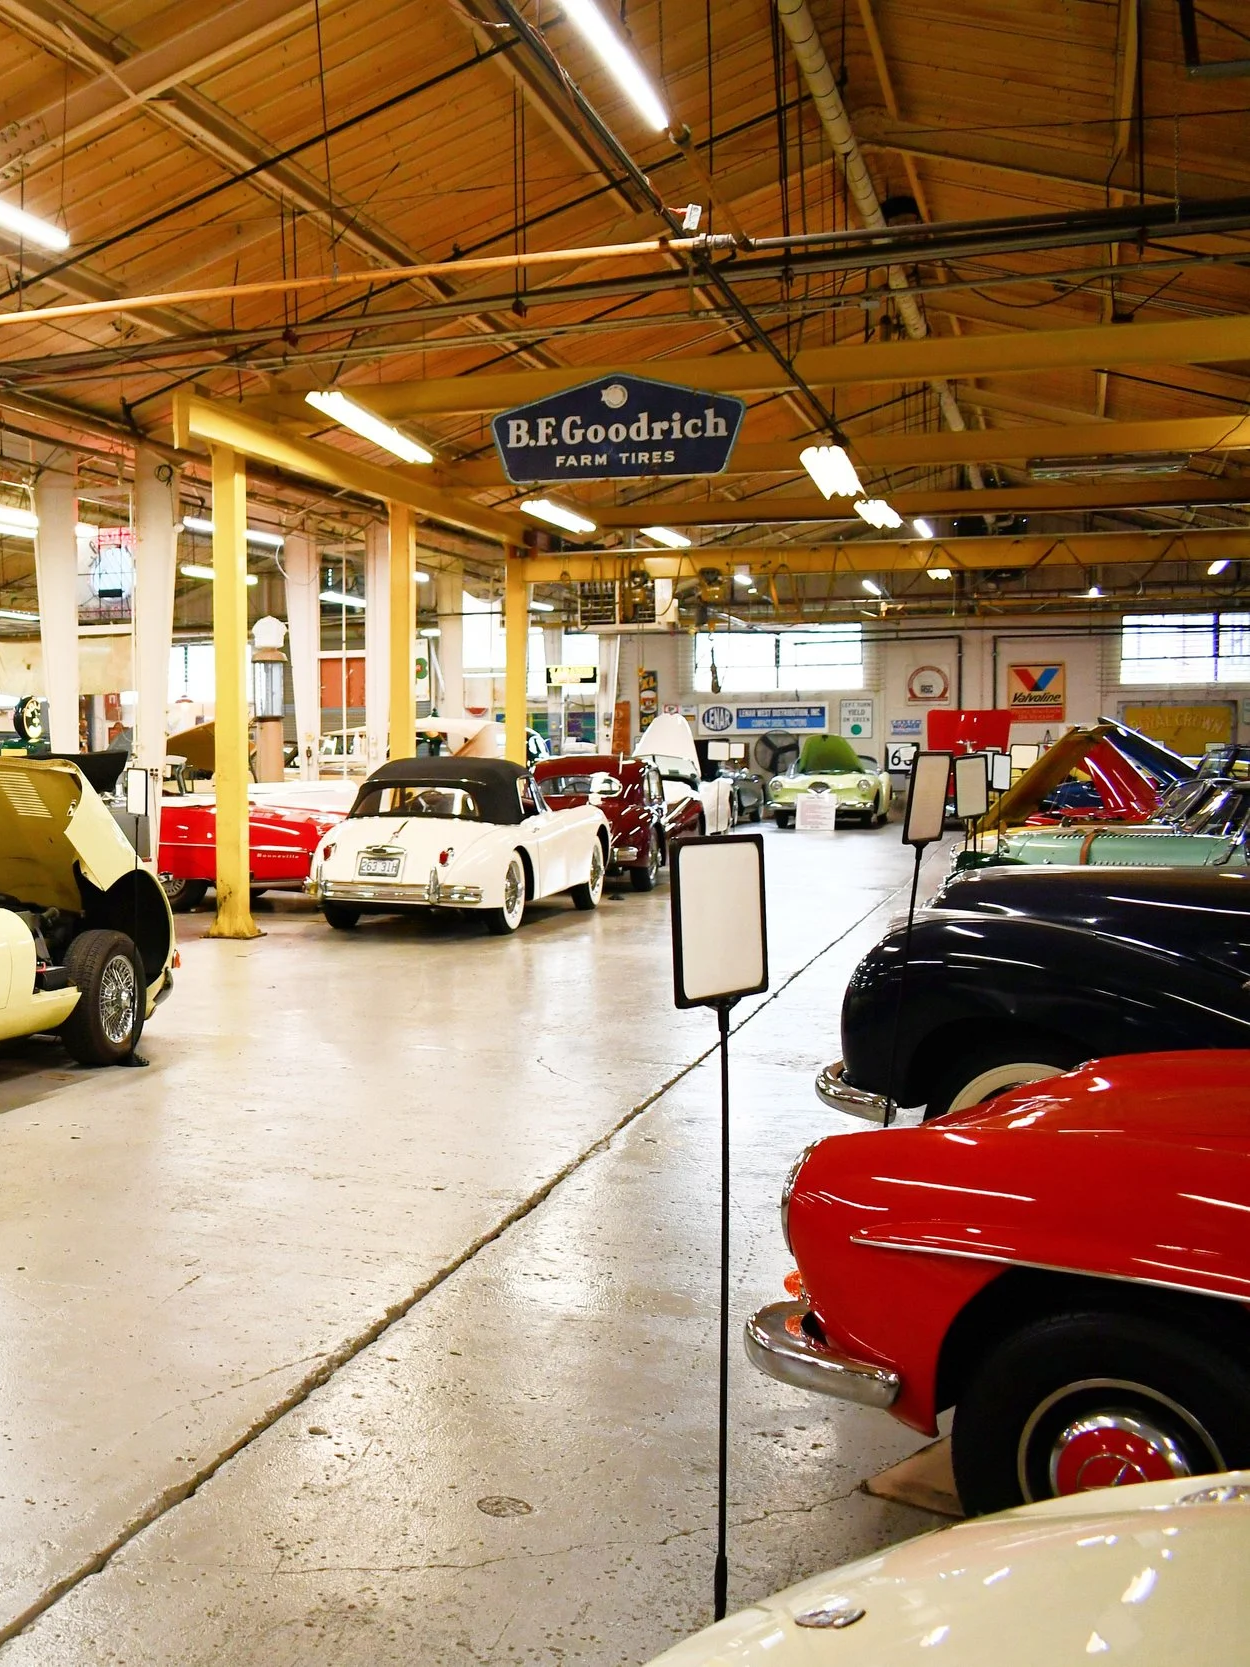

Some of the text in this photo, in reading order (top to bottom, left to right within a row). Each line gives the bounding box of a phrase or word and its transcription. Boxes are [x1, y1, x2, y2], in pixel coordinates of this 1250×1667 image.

[556, 451, 675, 467] FARM TIRES
[1012, 692, 1061, 703] Valvoline
[705, 707, 730, 730] LENAR
[1175, 711, 1224, 734] CROWN
[361, 861, 377, 872] 263
